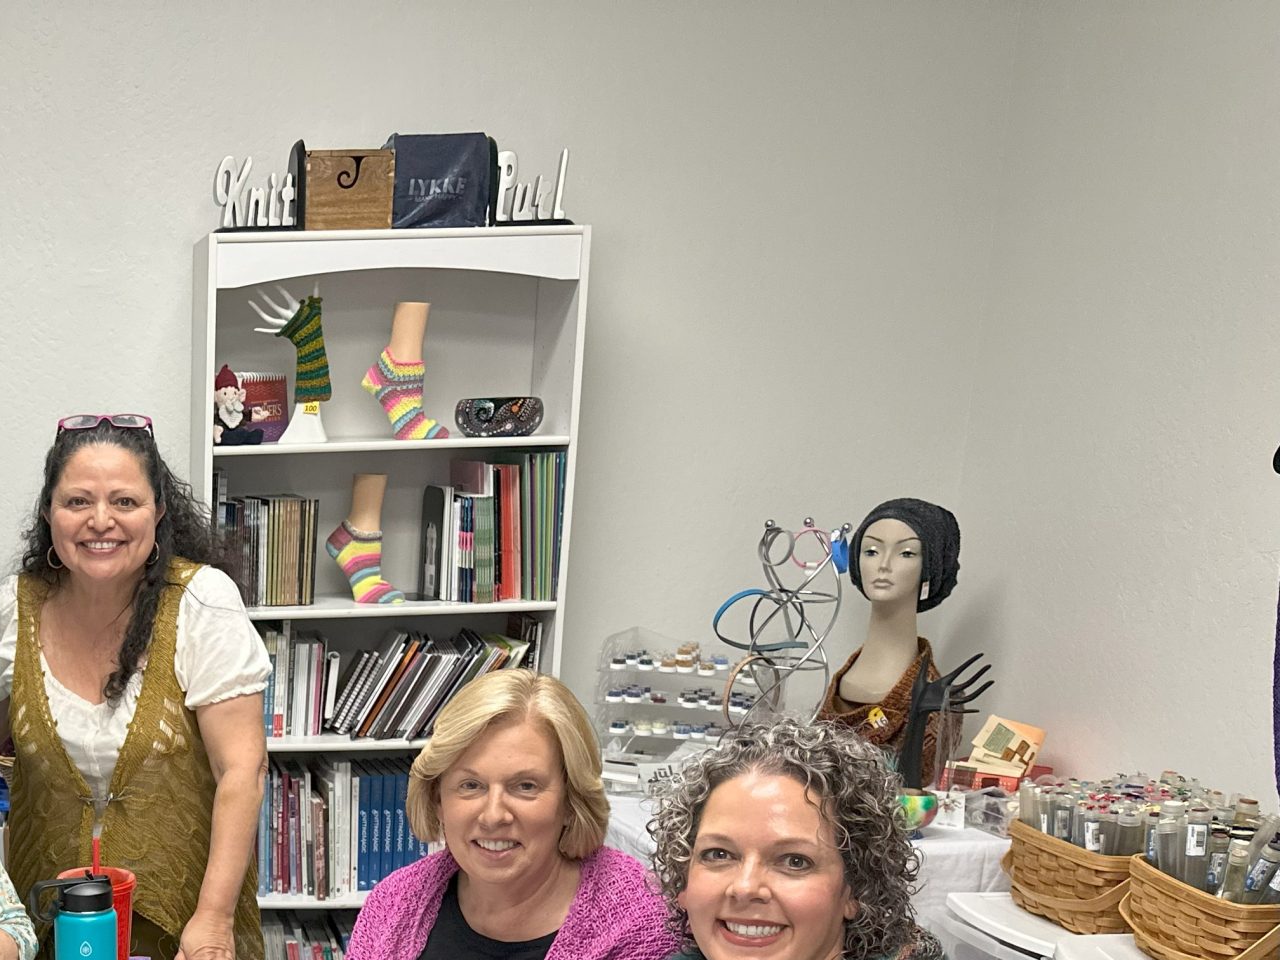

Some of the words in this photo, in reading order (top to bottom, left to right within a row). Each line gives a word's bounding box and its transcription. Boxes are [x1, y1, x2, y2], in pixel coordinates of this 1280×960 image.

[216, 154, 296, 227] Knit
[408, 177, 467, 196] LYKKE
[496, 148, 569, 221] Purl
